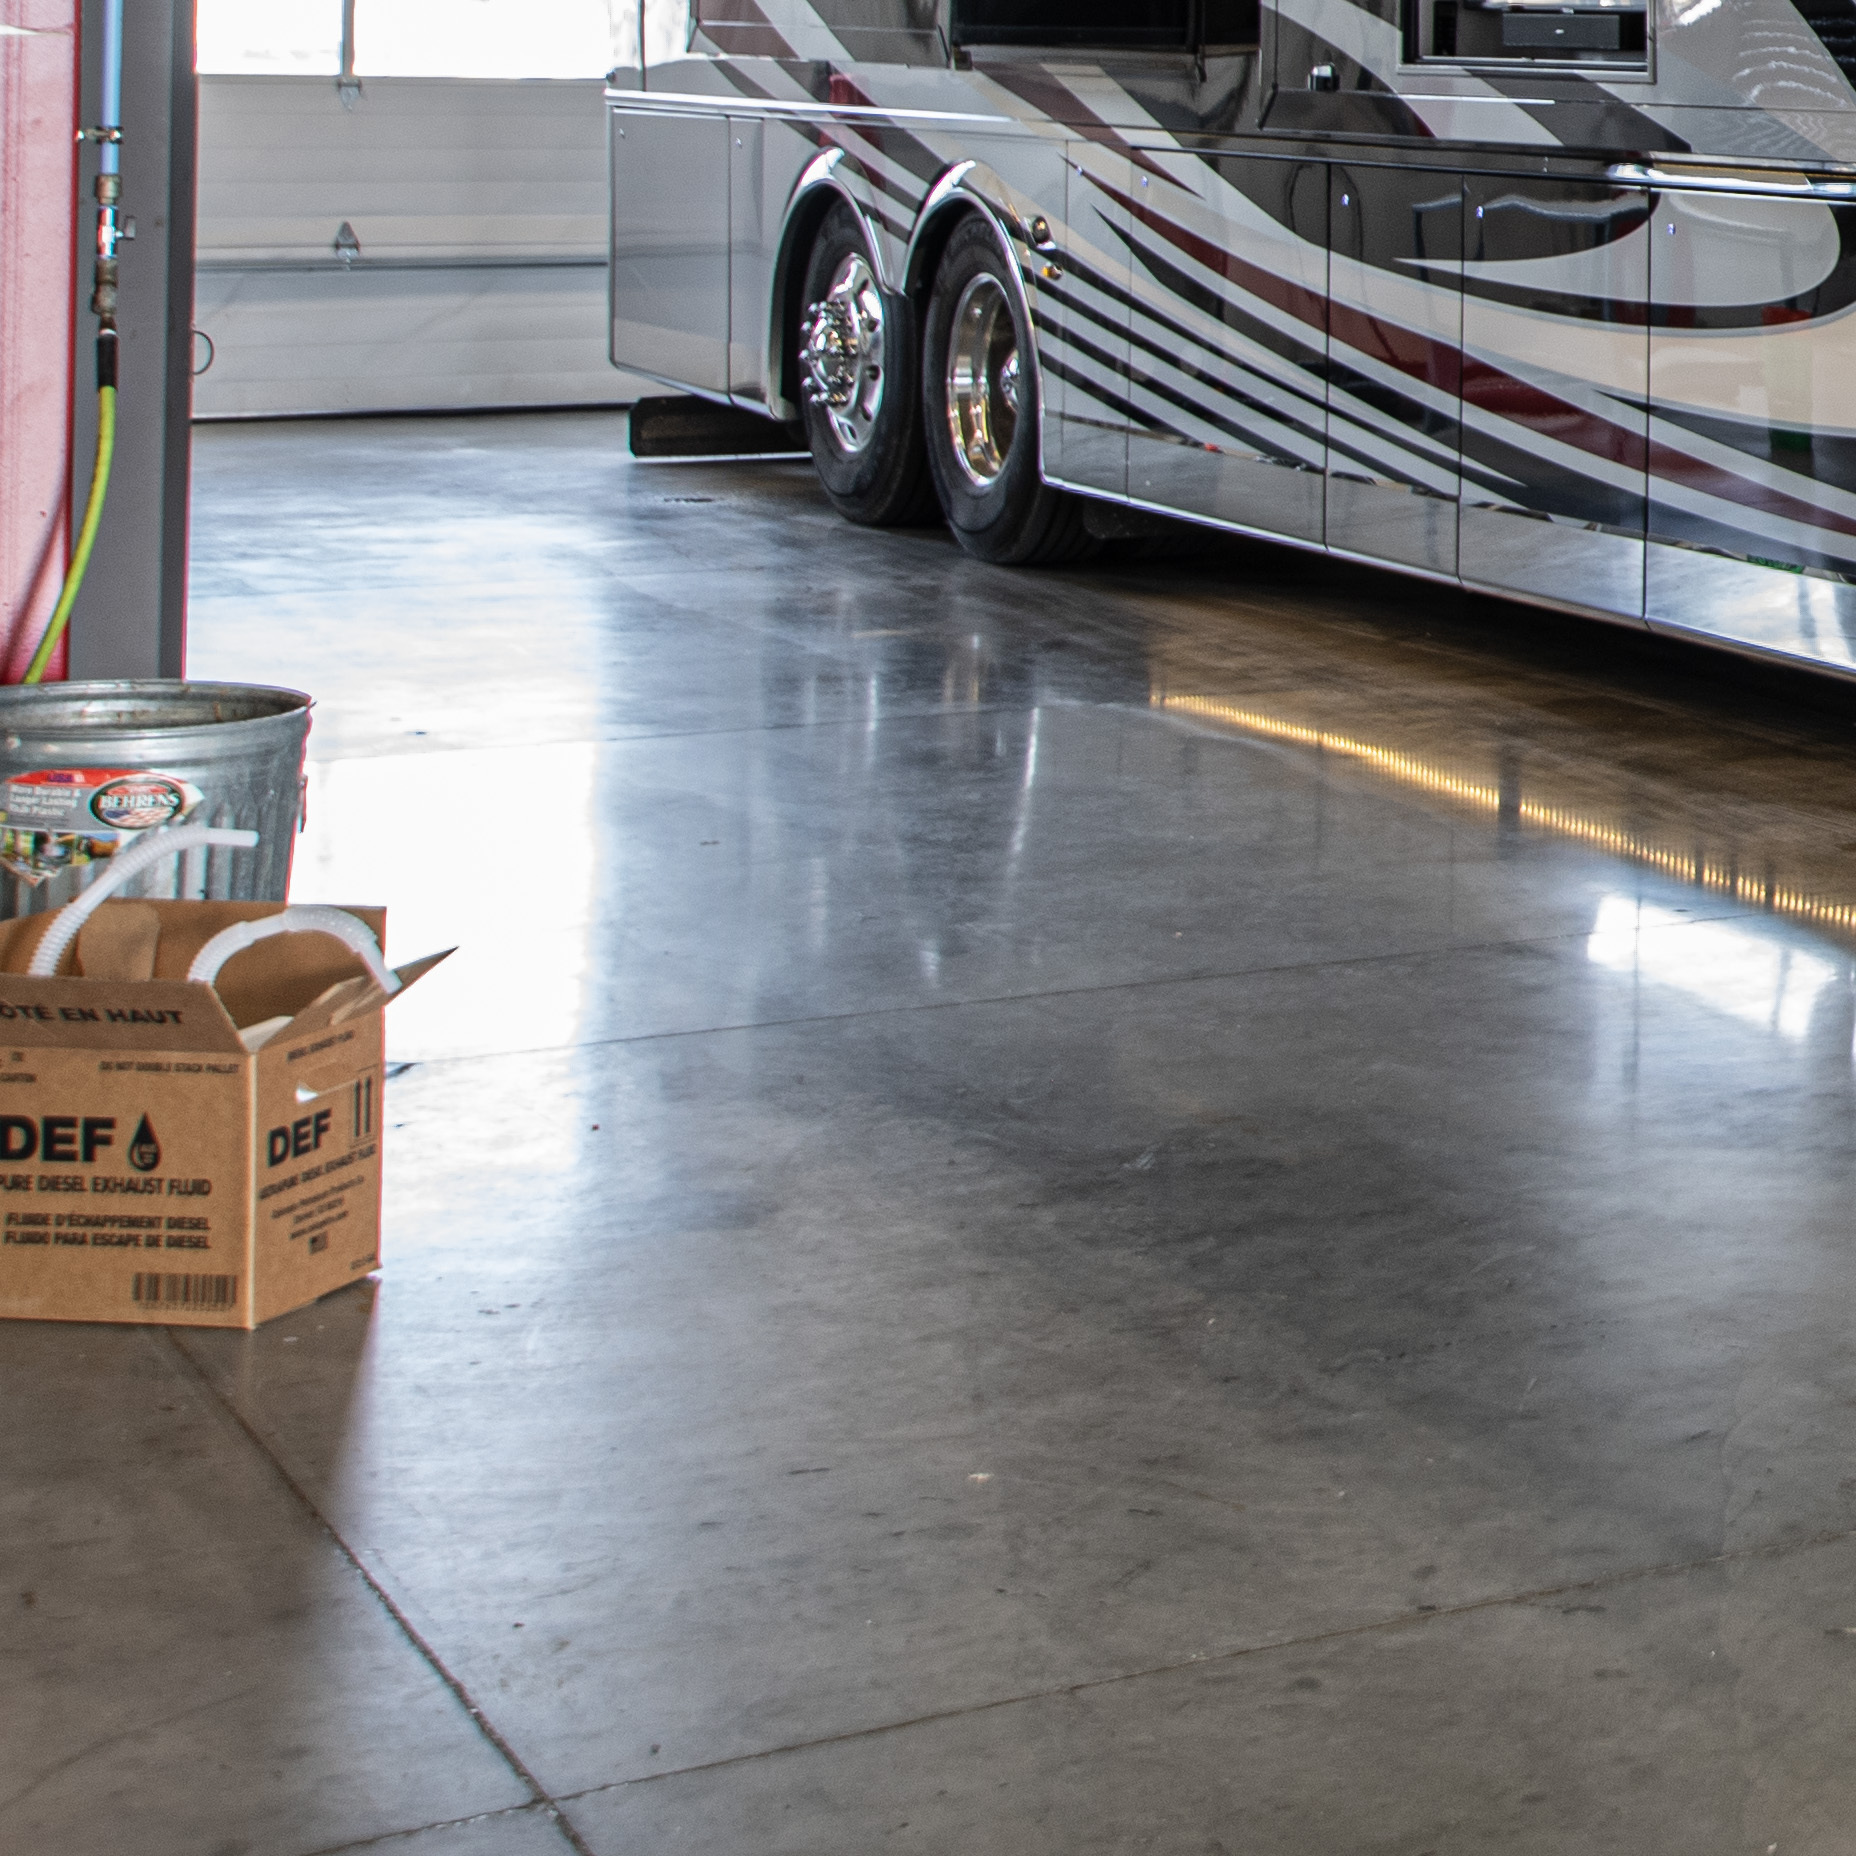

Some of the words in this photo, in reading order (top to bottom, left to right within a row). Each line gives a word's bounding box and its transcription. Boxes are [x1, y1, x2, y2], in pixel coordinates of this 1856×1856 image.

[100, 793, 181, 809] BEHRENS
[59, 1006, 100, 1022] EN
[104, 1007, 183, 1024] HAUT
[0, 1114, 117, 1162] DEF
[267, 1108, 332, 1167] DEF
[37, 1175, 87, 1192] DIESEL
[91, 1176, 164, 1194] EXHAUST
[167, 1178, 213, 1196] FLUID
[165, 1215, 211, 1230] DIESEL
[91, 1232, 142, 1247] ESCAPE
[144, 1233, 163, 1248] DE
[165, 1234, 211, 1249] DIESEL
